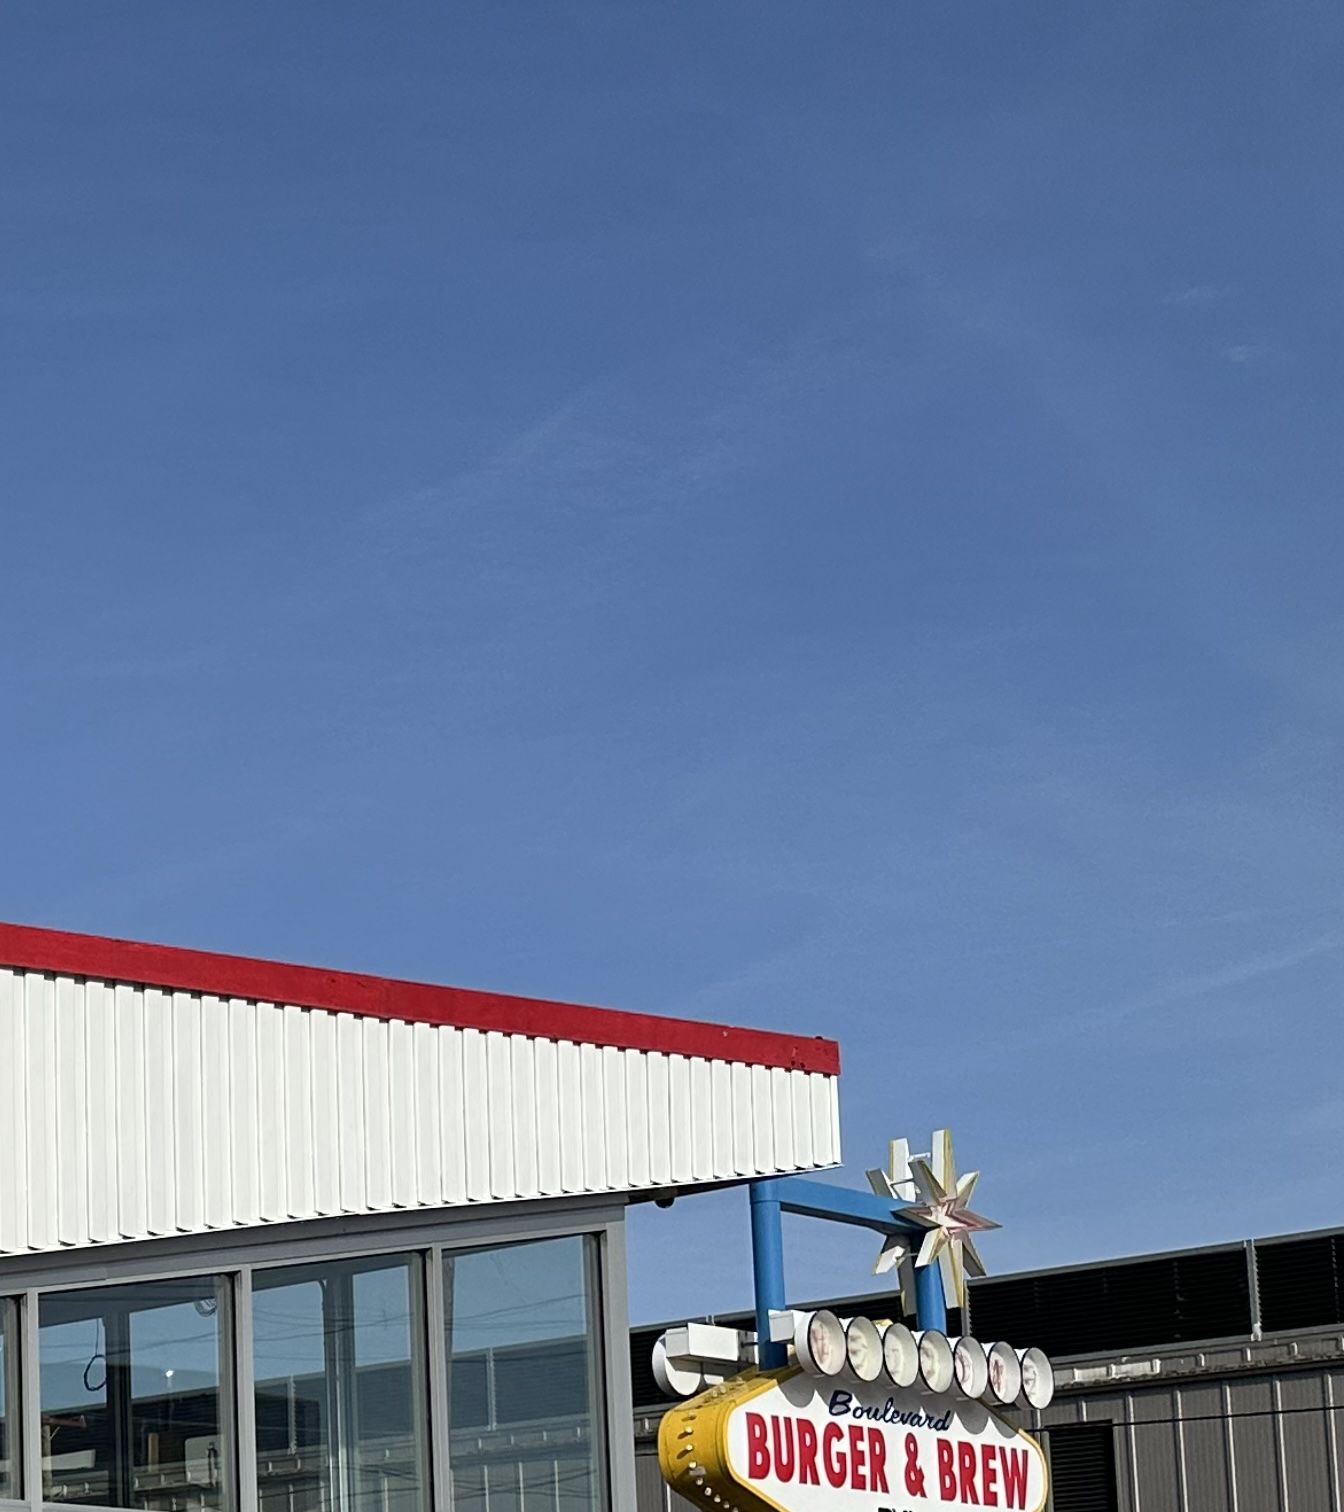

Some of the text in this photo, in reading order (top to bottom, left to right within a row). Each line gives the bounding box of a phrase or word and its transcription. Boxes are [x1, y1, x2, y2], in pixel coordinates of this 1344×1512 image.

[827, 1389, 952, 1432] Boulevard
[745, 1411, 1029, 1511] BURGER & BREW
